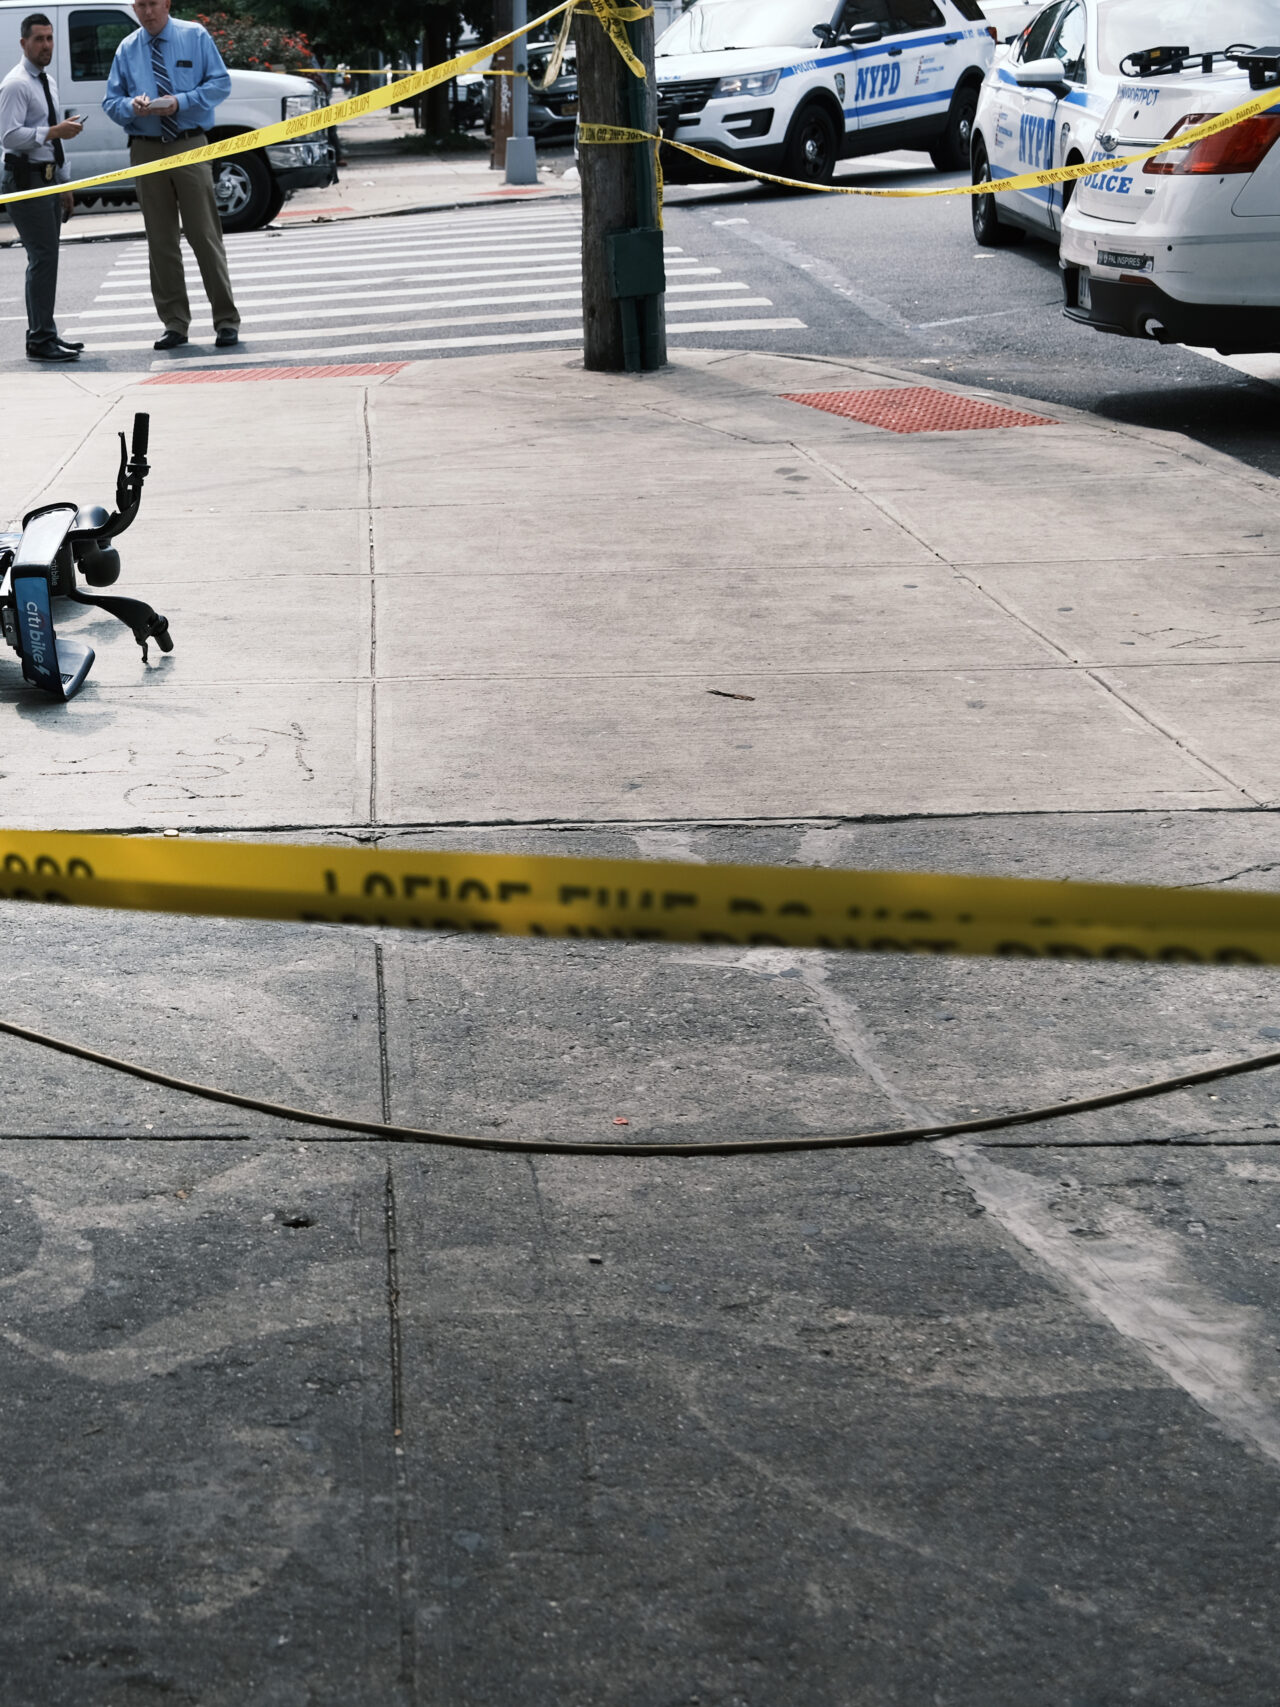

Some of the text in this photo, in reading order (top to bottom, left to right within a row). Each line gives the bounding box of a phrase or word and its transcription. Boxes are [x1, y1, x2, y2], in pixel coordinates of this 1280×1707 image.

[854, 62, 900, 102] NYPD
[1018, 113, 1055, 170] NYPD
[1117, 256, 1141, 267] INSPIRES
